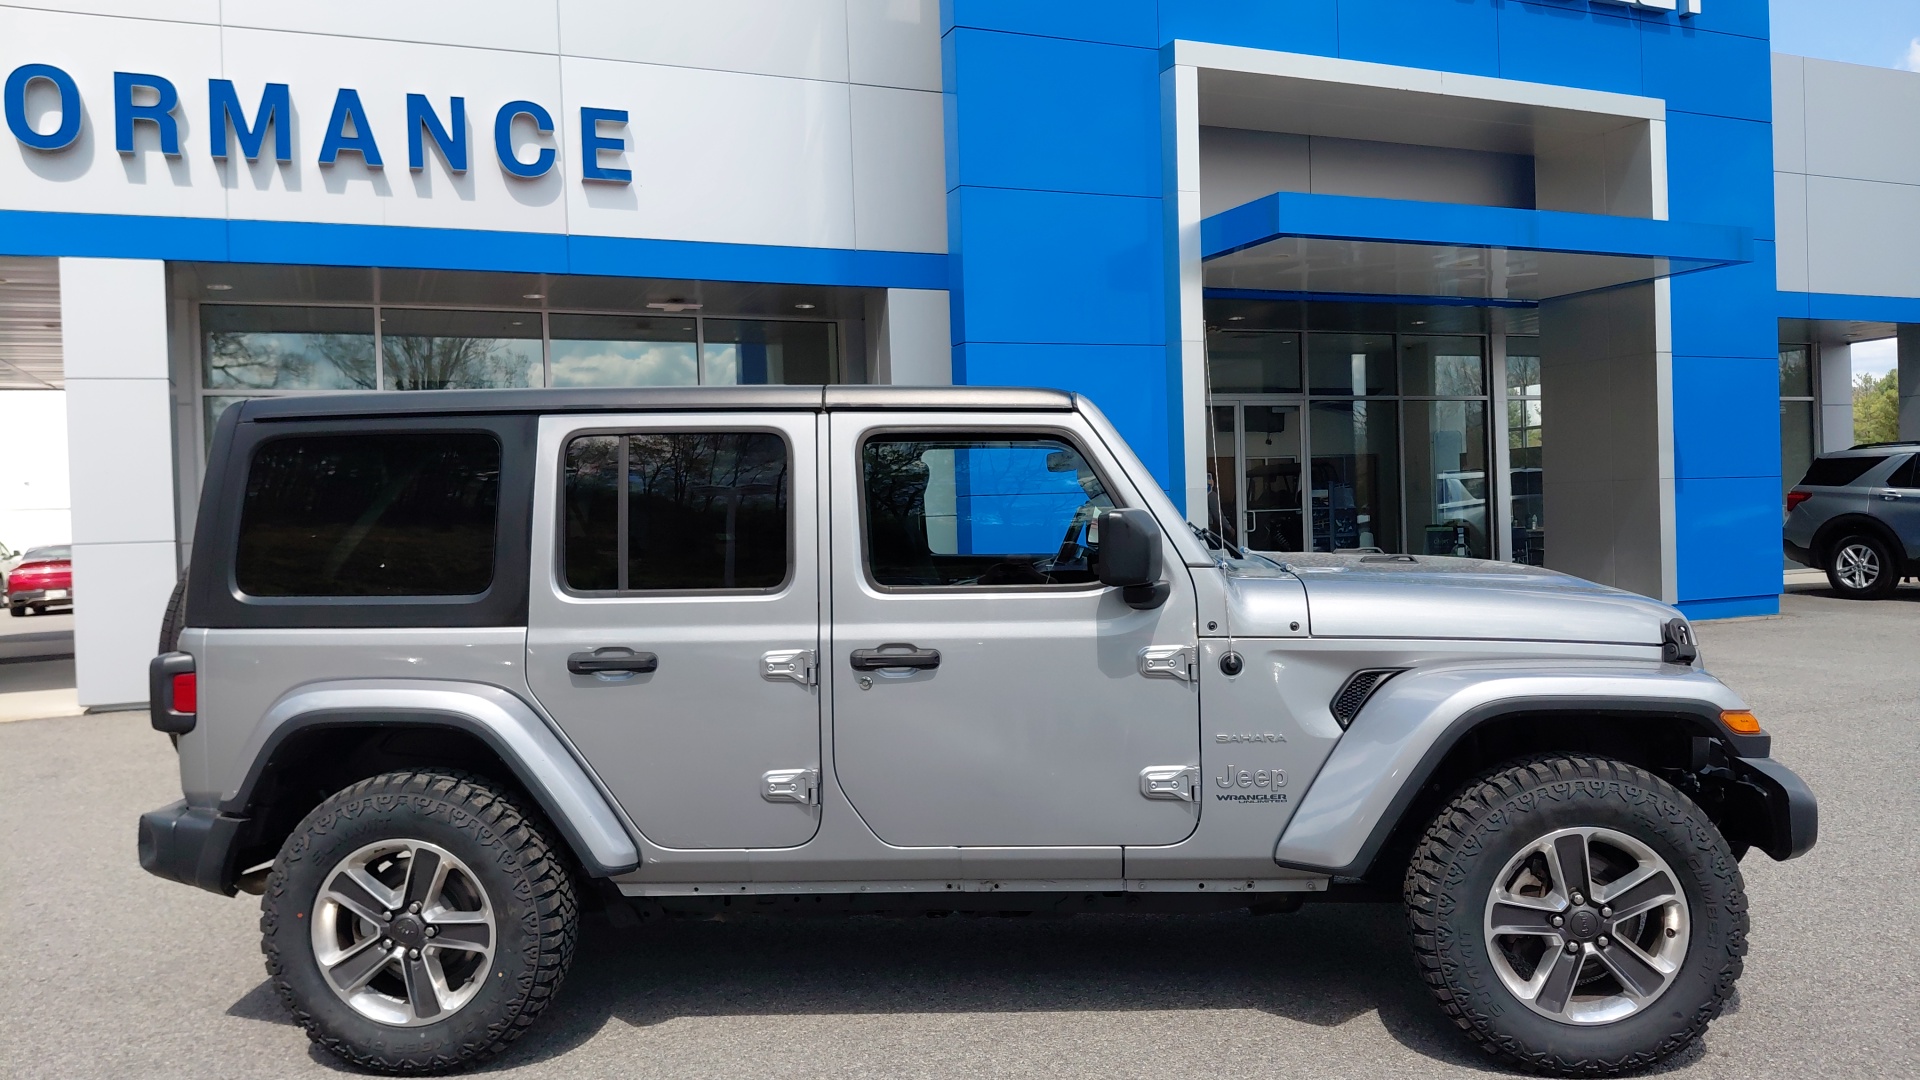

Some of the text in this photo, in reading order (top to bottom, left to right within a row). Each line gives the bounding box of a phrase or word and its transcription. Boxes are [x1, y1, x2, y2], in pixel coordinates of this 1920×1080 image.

[4, 62, 633, 185] ORMANCE
[1215, 733, 1287, 744] SAHARA
[1216, 764, 1289, 792] Jeep
[1458, 928, 1507, 1018] SUMMIT
